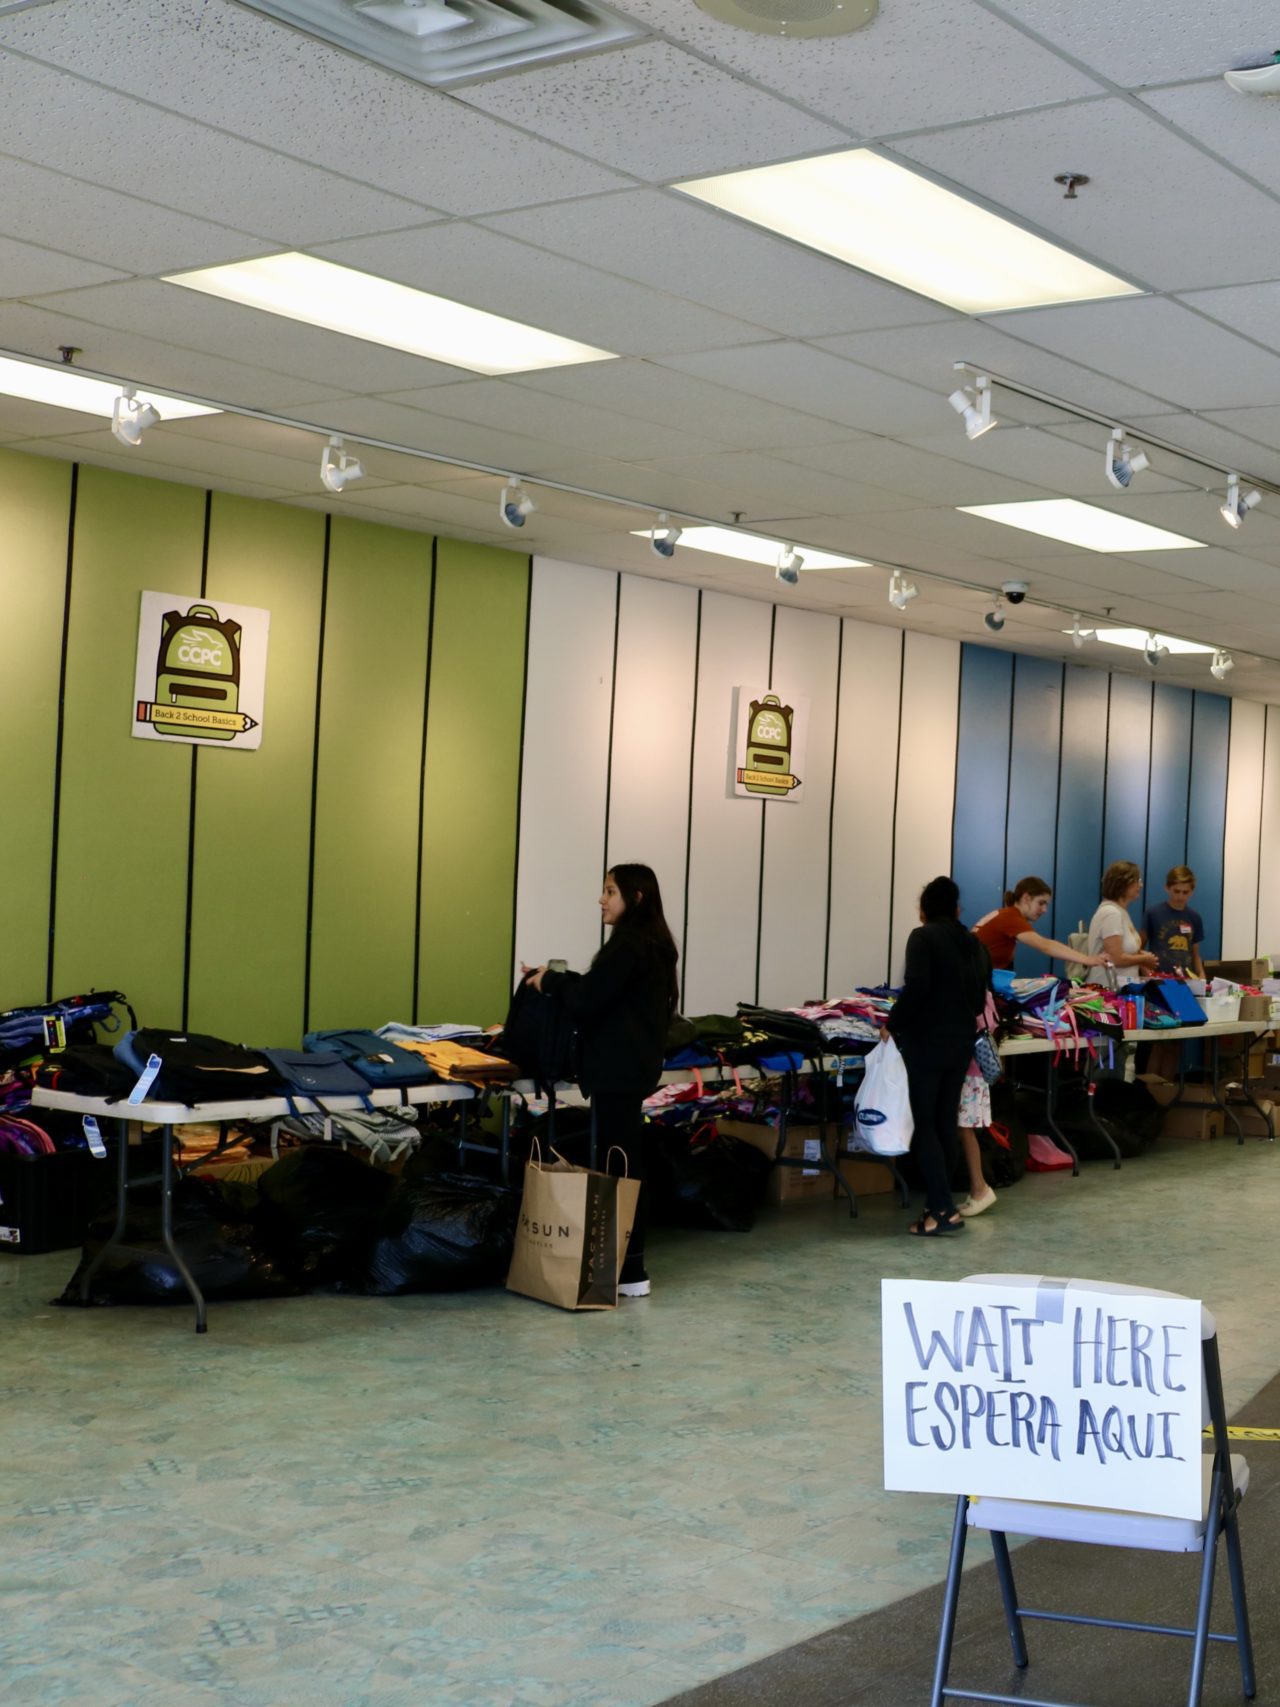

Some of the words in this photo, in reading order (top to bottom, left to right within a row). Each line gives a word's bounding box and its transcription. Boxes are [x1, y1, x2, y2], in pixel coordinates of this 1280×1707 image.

[177, 645, 222, 667] CCPC
[155, 709, 174, 720] Back
[175, 711, 181, 720] 2
[182, 712, 211, 724] School
[212, 716, 237, 726] Basics
[757, 726, 782, 740] CCPC
[903, 1302, 1044, 1383] WAIT
[1073, 1307, 1187, 1397] HERE
[904, 1381, 1063, 1462] ESPERA
[1076, 1398, 1187, 1465] AQUI
